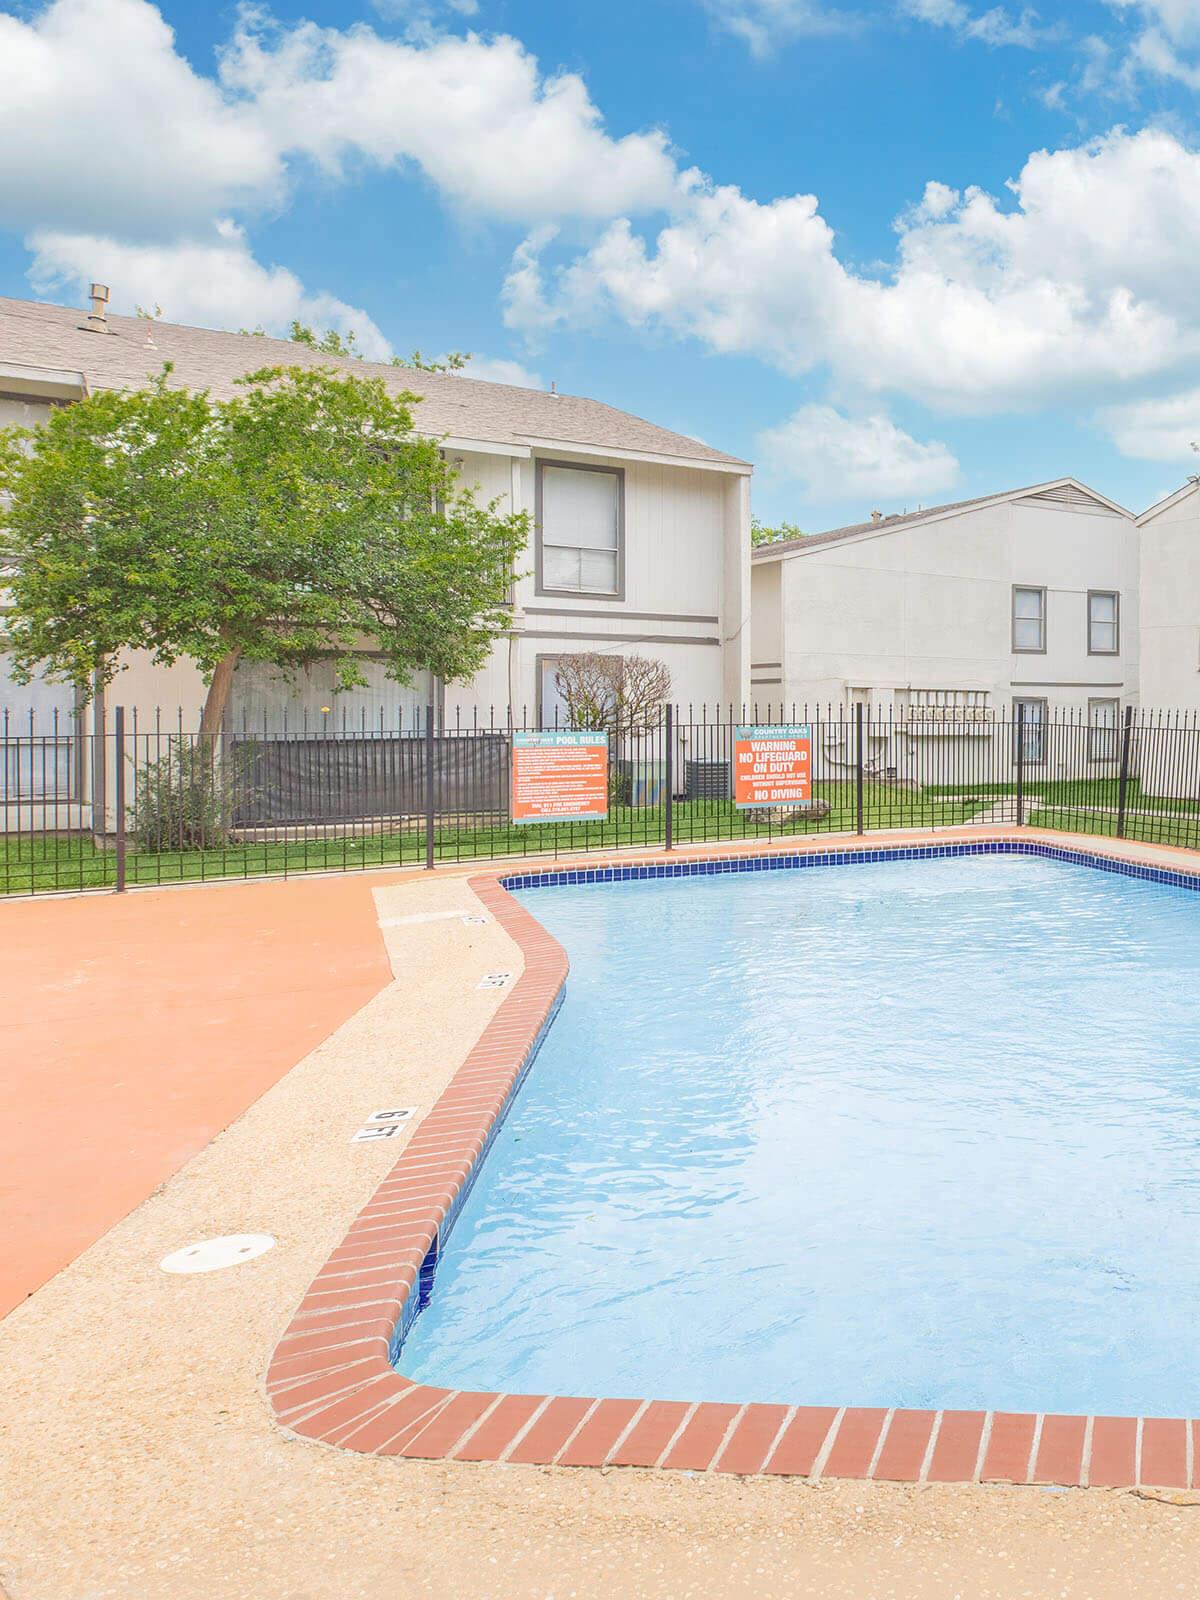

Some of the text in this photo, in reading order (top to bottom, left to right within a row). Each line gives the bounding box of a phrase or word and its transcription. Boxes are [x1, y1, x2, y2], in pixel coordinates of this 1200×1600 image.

[556, 735, 606, 745] POOL RULES
[751, 741, 796, 752] WARNING
[739, 751, 808, 763] NO LIFEGUARD
[753, 762, 794, 773] ON DUTY
[754, 788, 803, 801] NO DIVING
[358, 1110, 409, 1139] 6 FT
